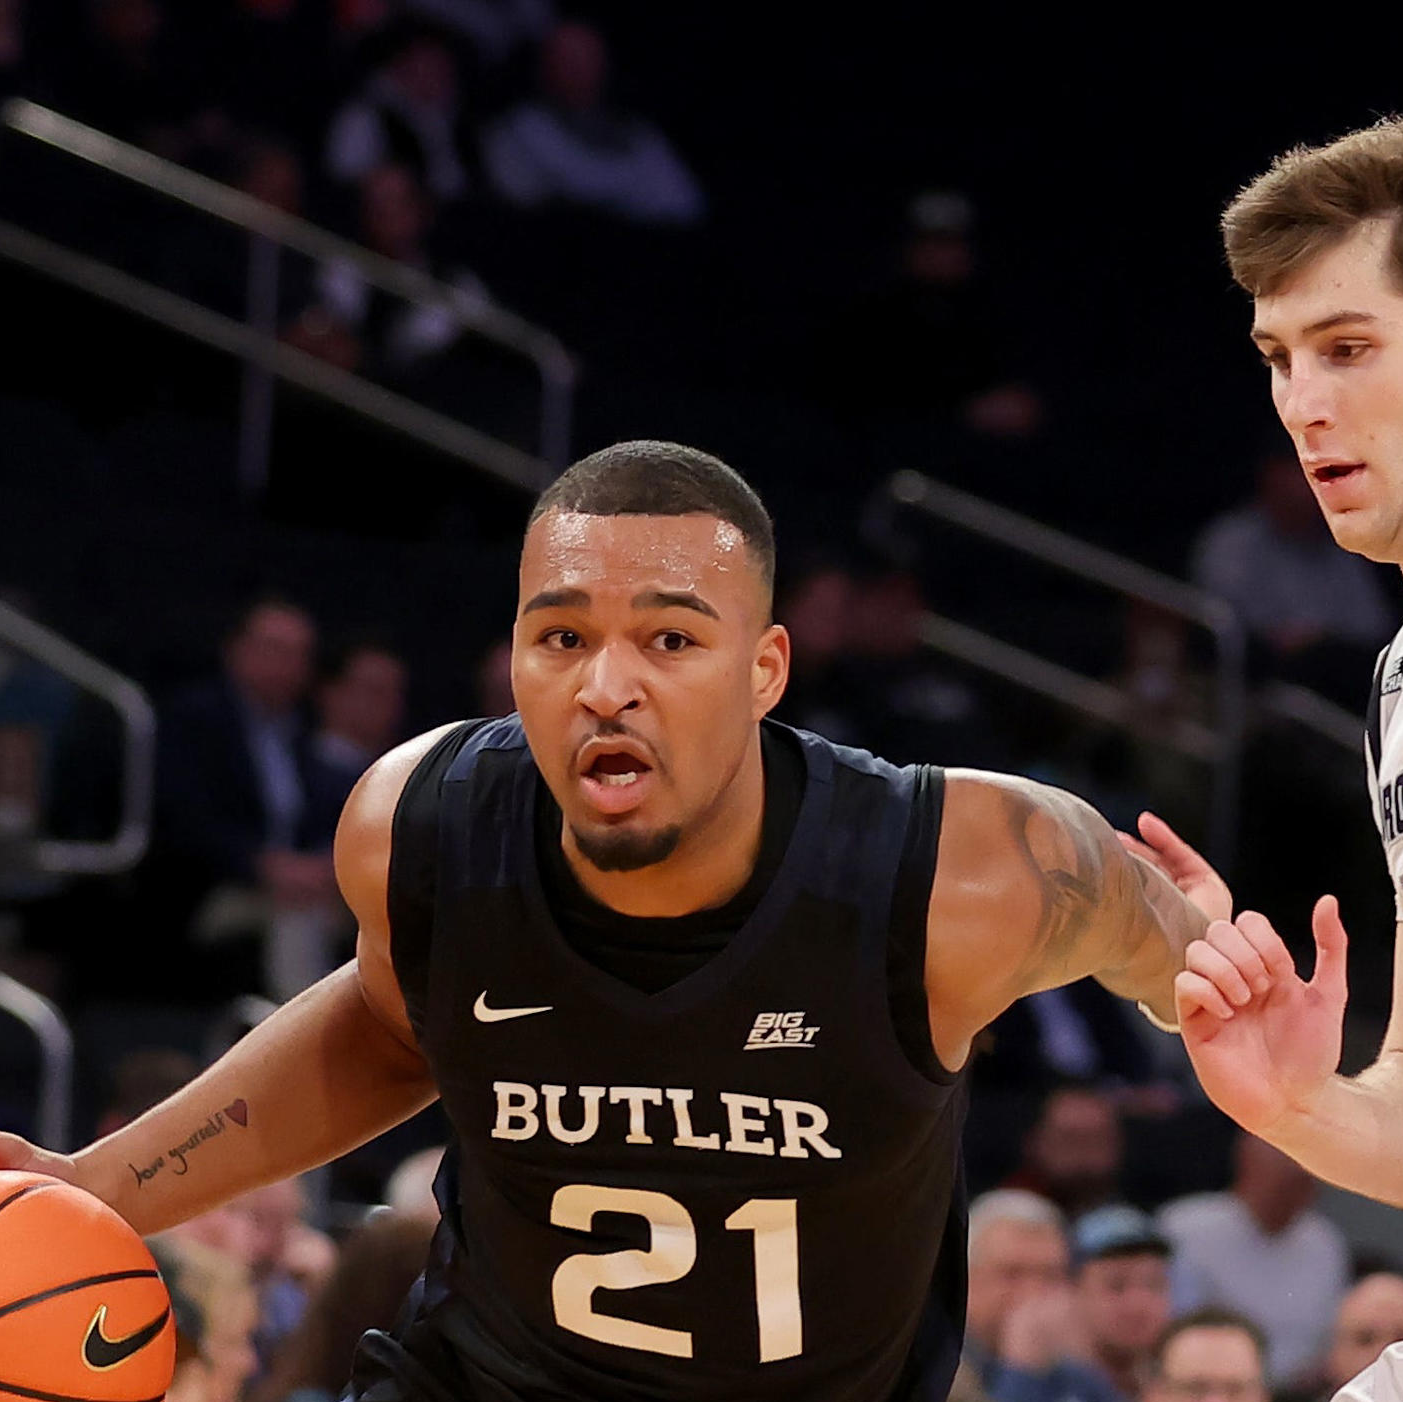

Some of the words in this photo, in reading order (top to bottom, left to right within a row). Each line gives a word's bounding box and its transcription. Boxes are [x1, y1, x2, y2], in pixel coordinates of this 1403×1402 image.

[747, 1026, 821, 1043] EAST
[753, 1011, 806, 1029] BIG
[491, 1081, 842, 1159] BUTLER
[550, 1184, 802, 1364] 21
